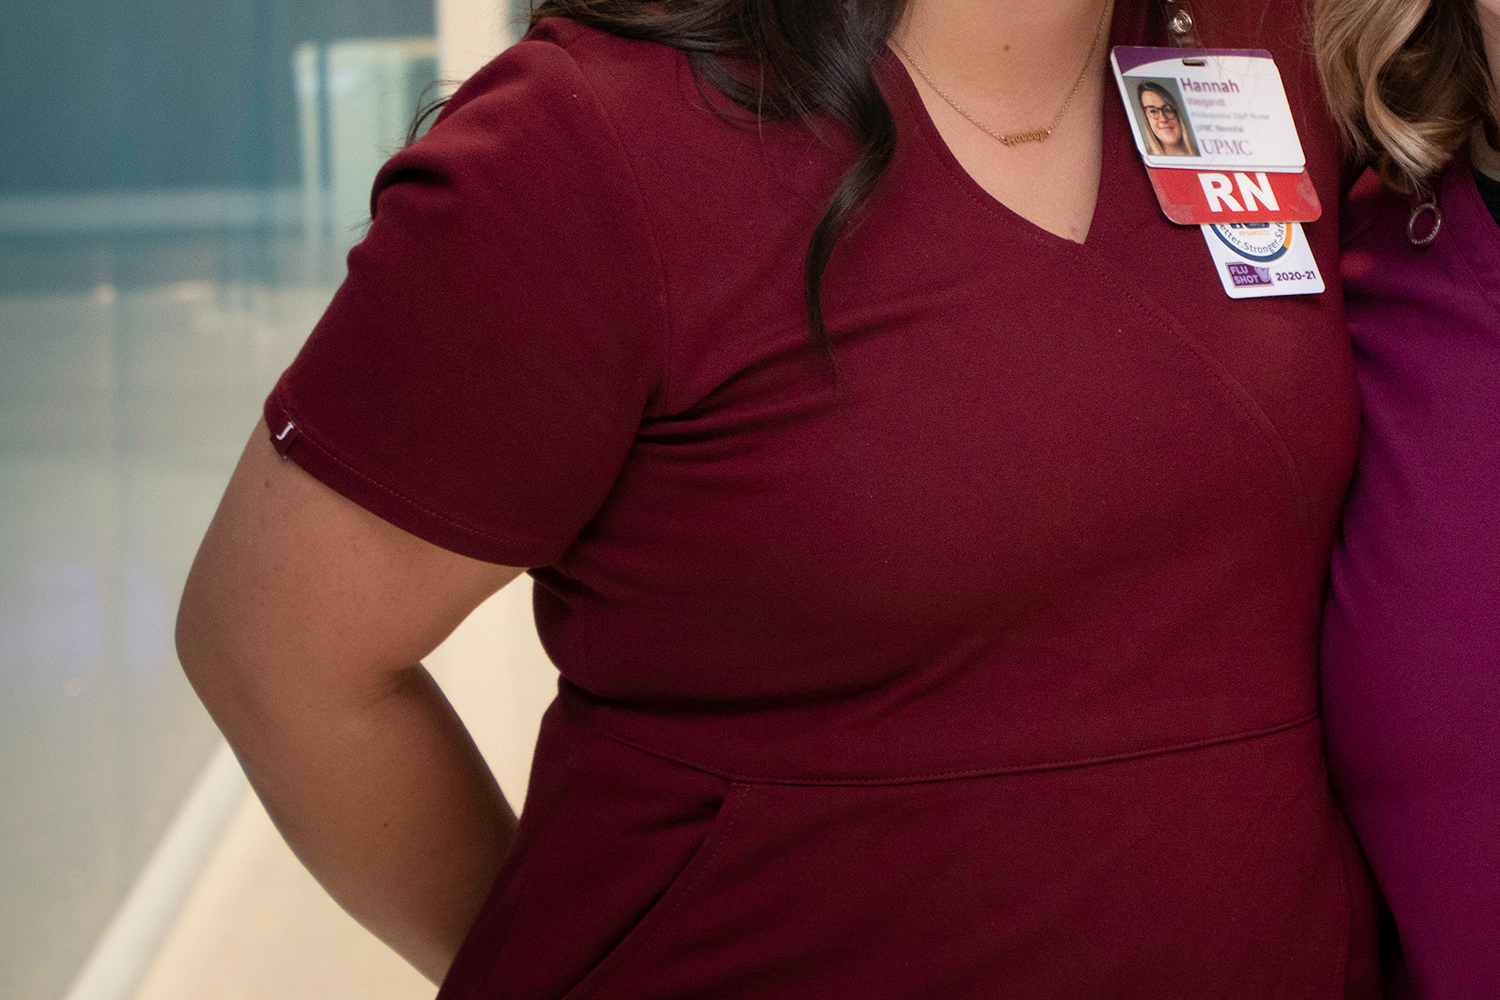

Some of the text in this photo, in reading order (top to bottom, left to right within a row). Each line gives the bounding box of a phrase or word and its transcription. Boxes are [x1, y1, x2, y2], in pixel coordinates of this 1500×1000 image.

[1180, 77, 1240, 93] Hannah
[1200, 138, 1253, 155] UPMC
[1197, 172, 1280, 212] RN
[1229, 266, 1249, 275] FLU
[1275, 270, 1316, 281] 2020-21
[1234, 275, 1259, 285] SHOT
